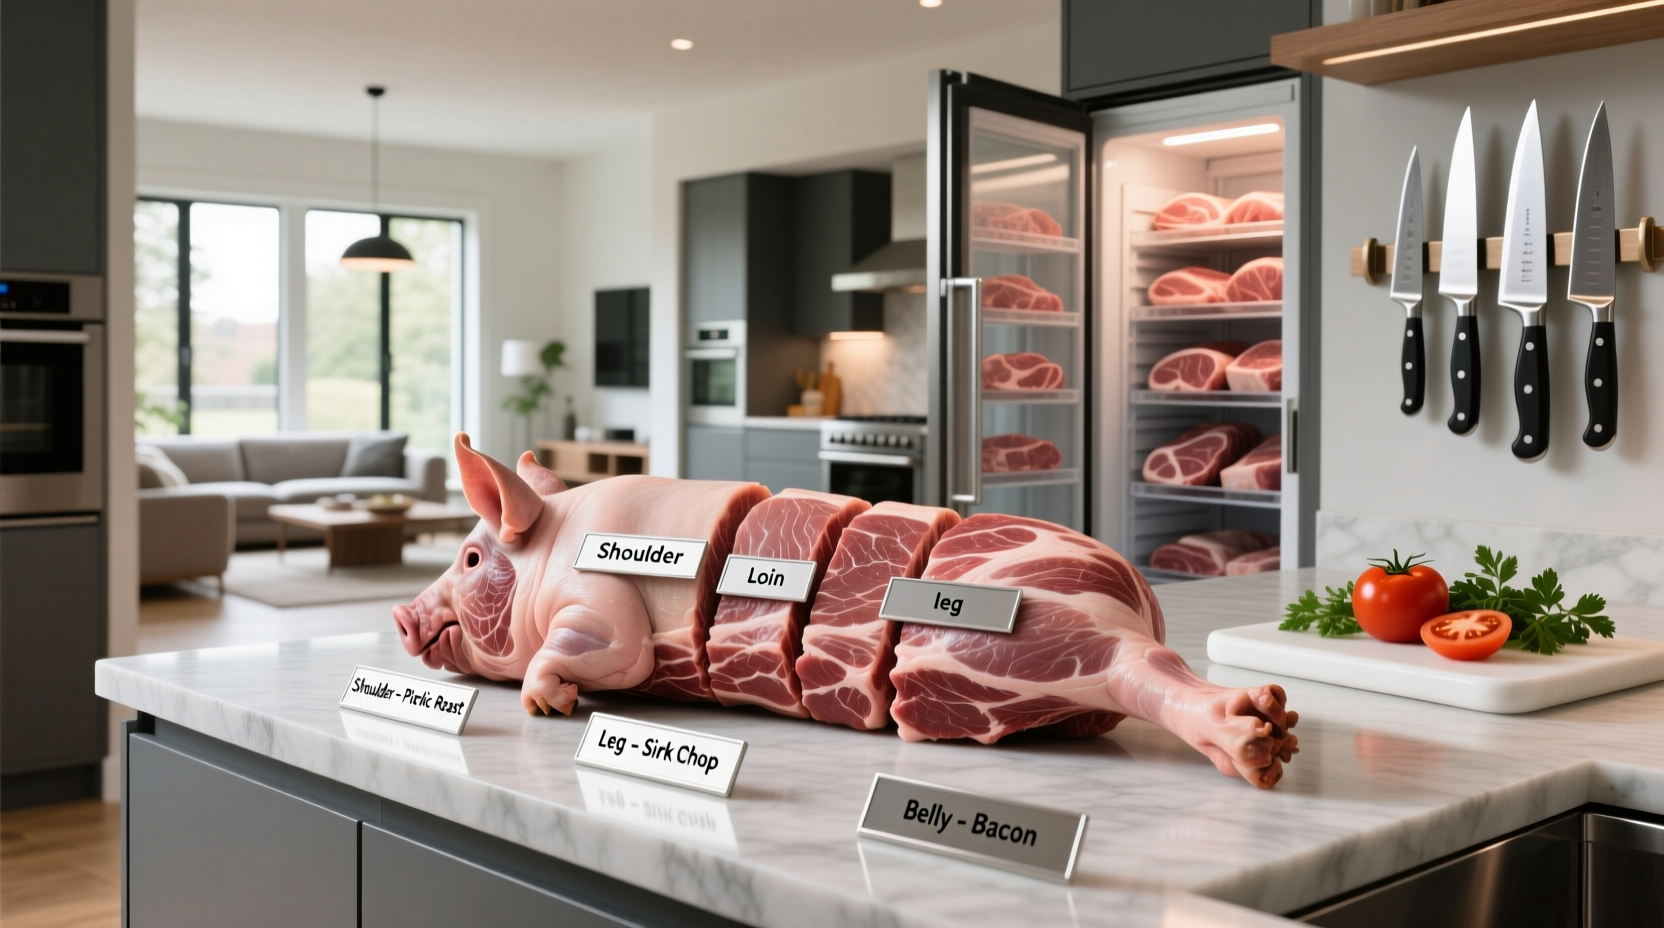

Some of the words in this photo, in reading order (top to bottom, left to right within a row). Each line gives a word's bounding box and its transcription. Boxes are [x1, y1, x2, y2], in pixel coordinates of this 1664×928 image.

[597, 541, 685, 565] Shoulder
[747, 566, 786, 587] Loin
[932, 591, 964, 617] leg
[598, 729, 627, 756] Leg
[641, 738, 674, 762] Sirk
[676, 745, 719, 776] Chop
[903, 798, 954, 835] Belly
[970, 812, 1038, 847] Bacon
